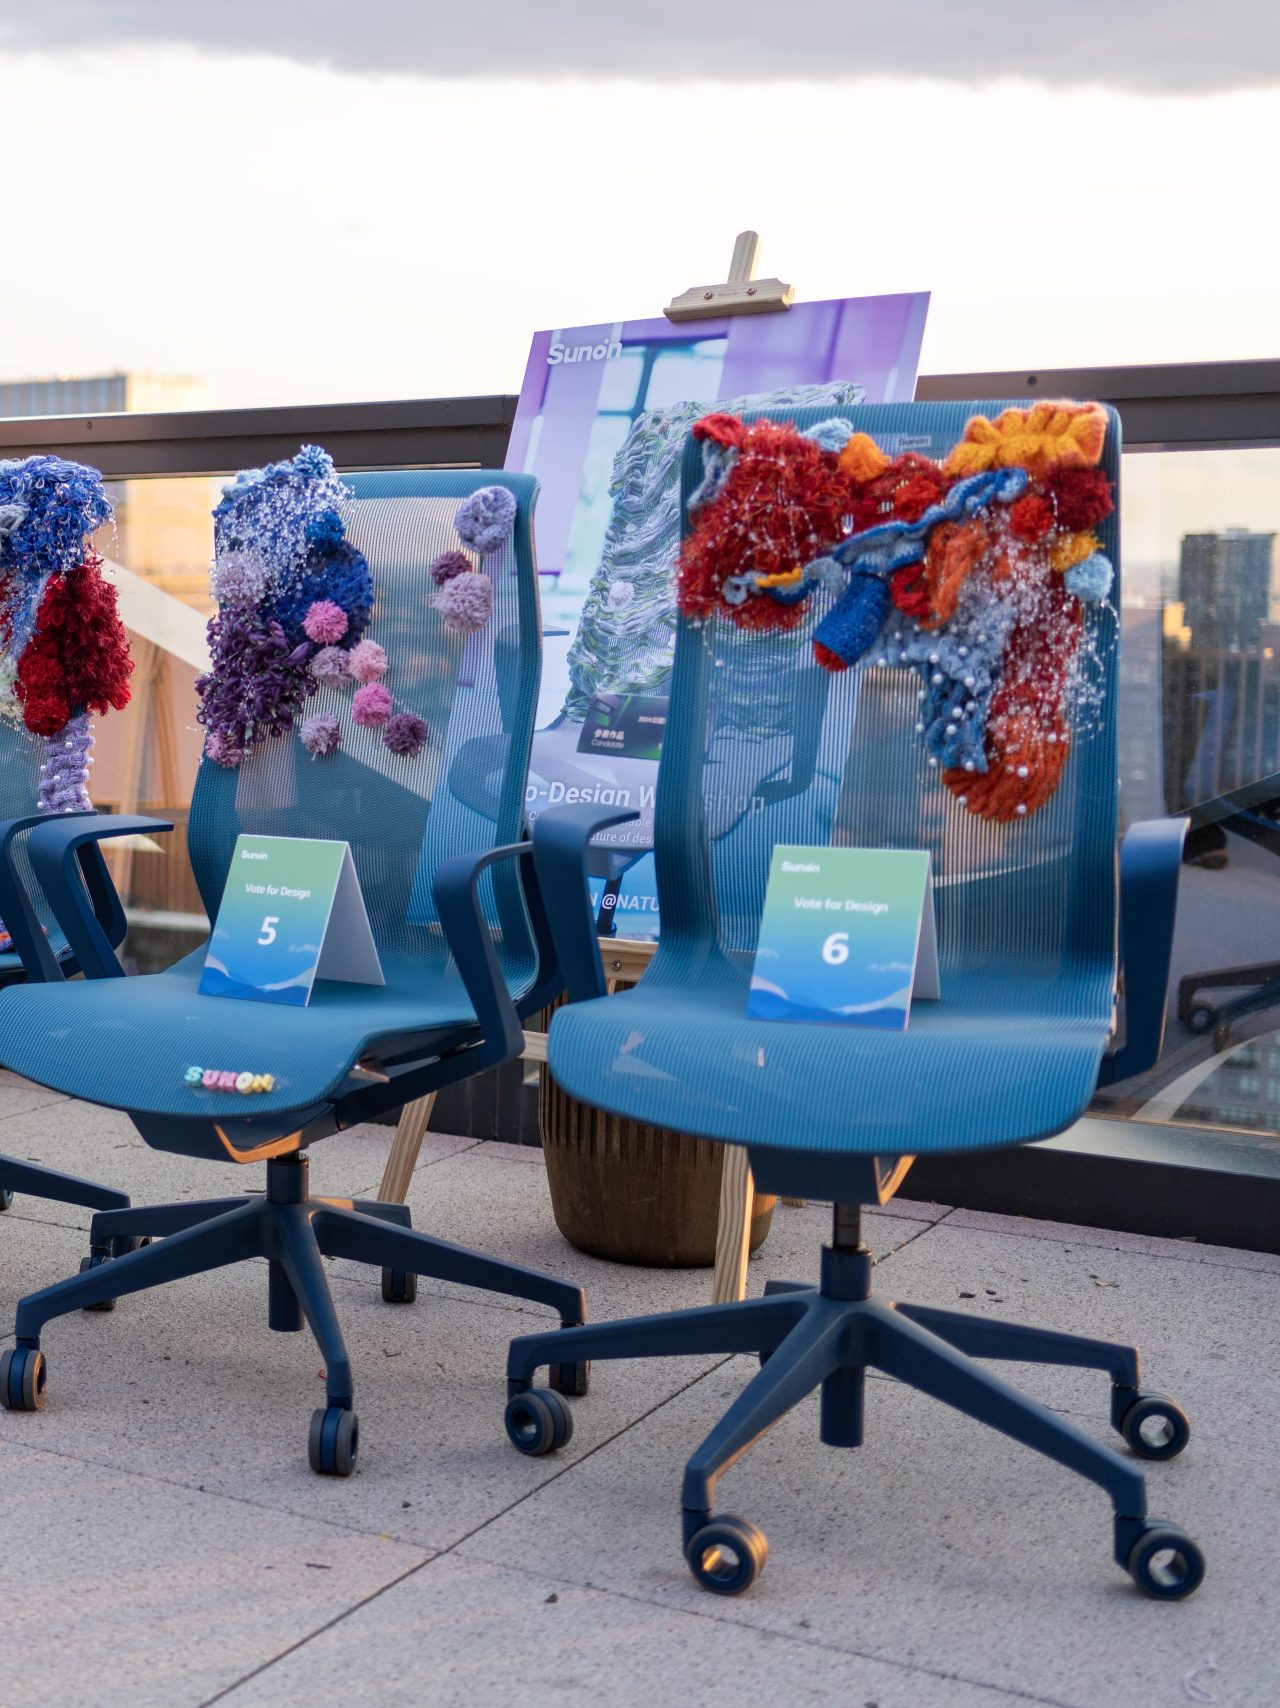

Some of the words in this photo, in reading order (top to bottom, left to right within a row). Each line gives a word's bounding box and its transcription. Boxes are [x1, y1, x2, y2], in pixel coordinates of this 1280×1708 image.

[546, 338, 623, 366] Sunon
[525, 781, 631, 807] o-Design
[620, 832, 632, 844] of
[240, 849, 269, 861] Sunon
[780, 861, 821, 873] Sunon
[245, 883, 266, 894] Vote
[266, 884, 280, 895] for
[280, 886, 311, 900] Design
[601, 893, 660, 912] @NATU
[793, 896, 822, 910] Vote
[824, 898, 842, 911] for
[845, 899, 890, 916] Design
[257, 915, 280, 946] 5
[821, 931, 850, 966] 6
